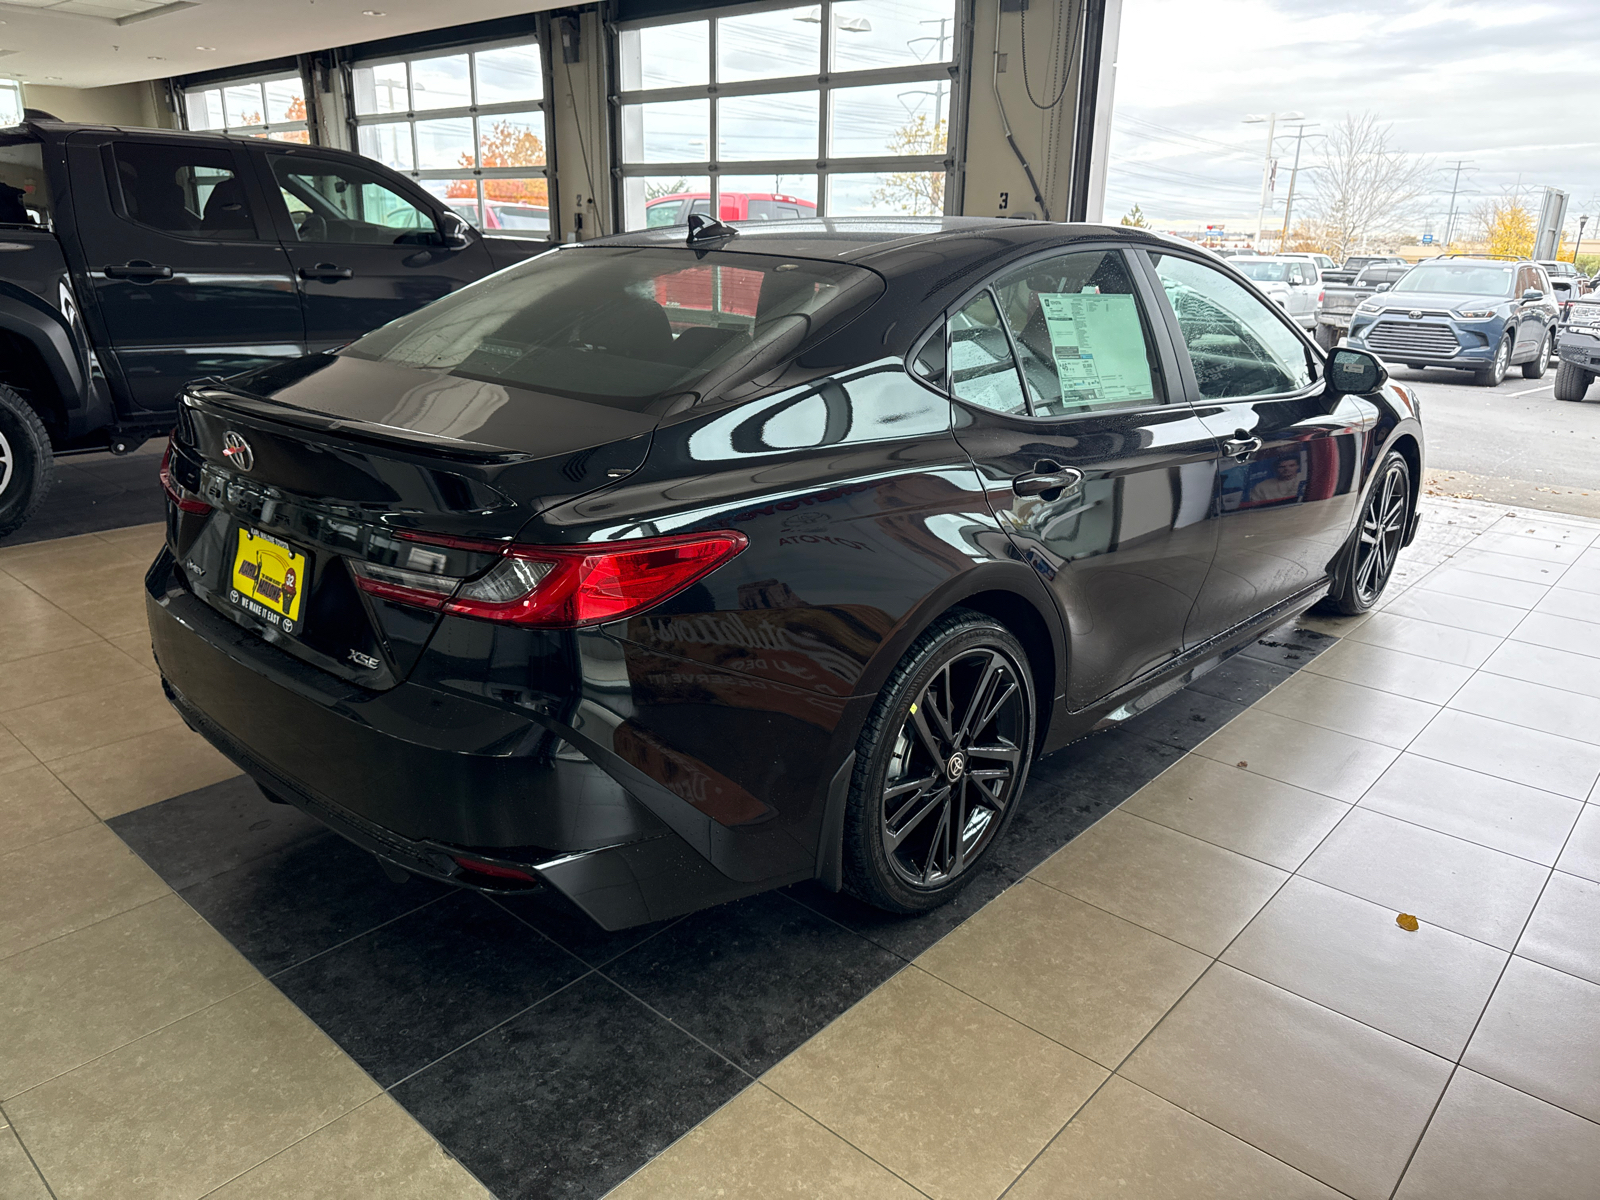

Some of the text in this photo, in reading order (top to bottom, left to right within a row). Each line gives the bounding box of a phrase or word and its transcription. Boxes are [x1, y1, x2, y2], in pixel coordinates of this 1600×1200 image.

[576, 194, 582, 207] 2
[999, 192, 1009, 210] 3
[286, 573, 295, 587] 32
[256, 578, 283, 604] MALONE
[241, 596, 280, 625] WE MAKE IT EASY
[347, 648, 381, 670] XSE
